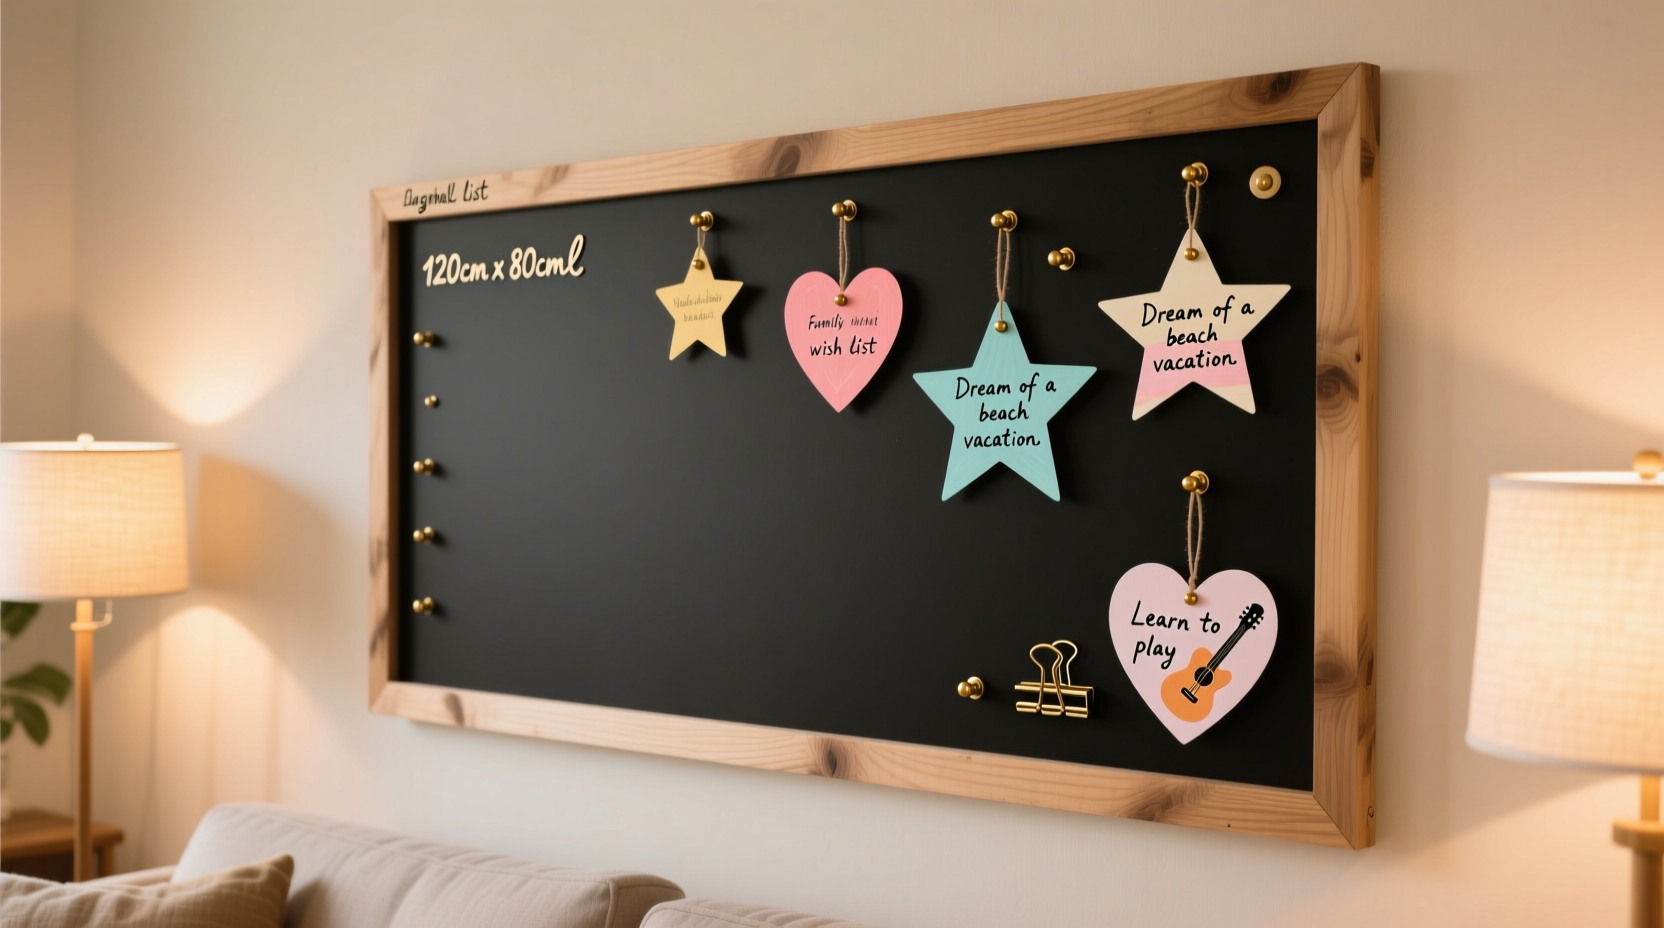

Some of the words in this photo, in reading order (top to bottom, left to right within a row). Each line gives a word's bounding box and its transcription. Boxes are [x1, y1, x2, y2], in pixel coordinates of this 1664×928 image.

[422, 252, 489, 287] 120cm
[491, 259, 505, 281] x
[1141, 302, 1203, 327] Dream
[1213, 294, 1236, 324] of
[1241, 303, 1255, 315] a
[810, 336, 842, 356] wish
[1166, 322, 1218, 347] beach
[1153, 349, 1237, 373] vacation
[955, 376, 1011, 400] Dream
[1019, 372, 1040, 402] of
[1045, 380, 1057, 393] a
[979, 400, 1030, 422] beach
[964, 428, 1041, 449] vacation
[1131, 600, 1190, 631] Learn
[1199, 611, 1221, 634] to
[1132, 634, 1176, 670] play
